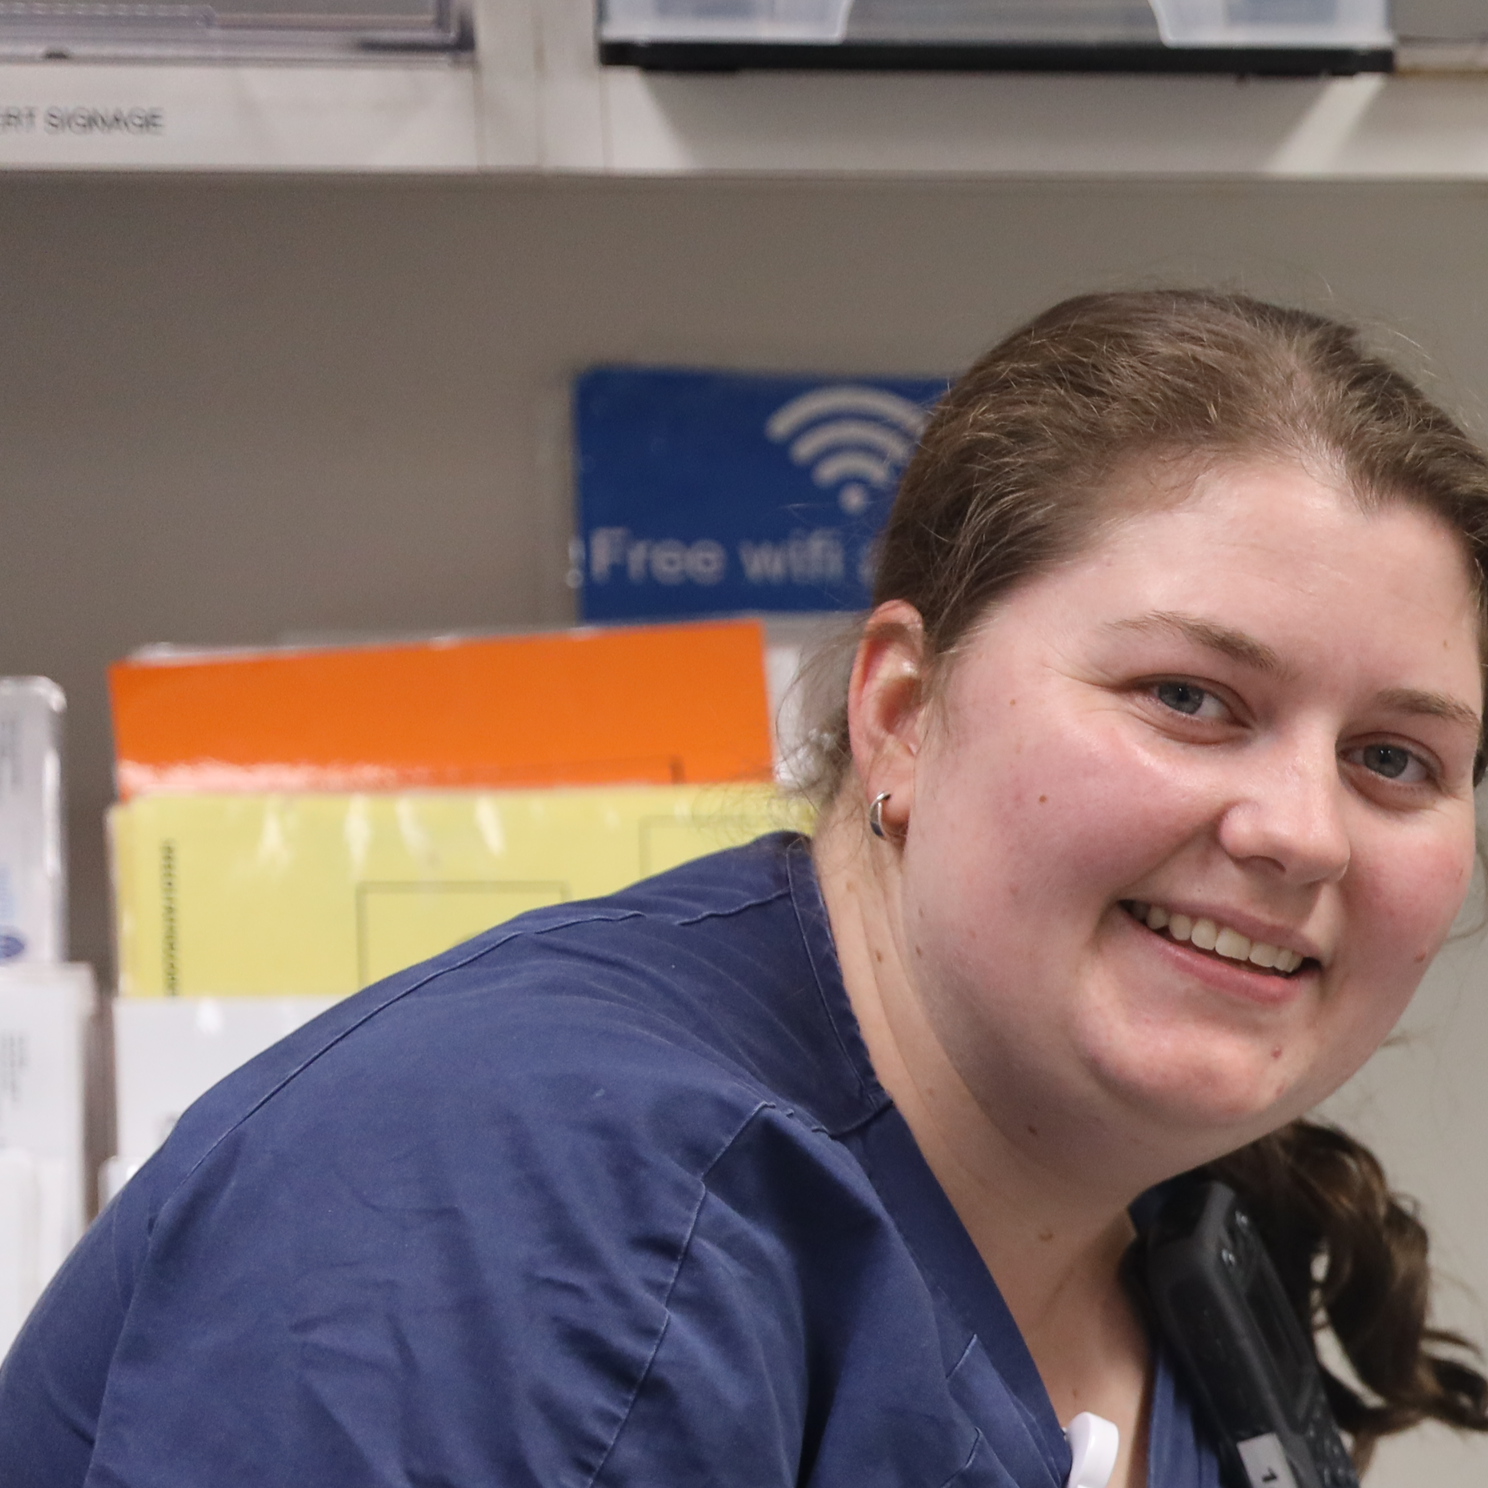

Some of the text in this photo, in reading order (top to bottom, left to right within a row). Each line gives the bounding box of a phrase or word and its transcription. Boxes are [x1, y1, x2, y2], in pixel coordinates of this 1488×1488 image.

[45, 106, 165, 135] SIGNAGE
[590, 525, 728, 587] Free
[736, 526, 846, 586] wifi
